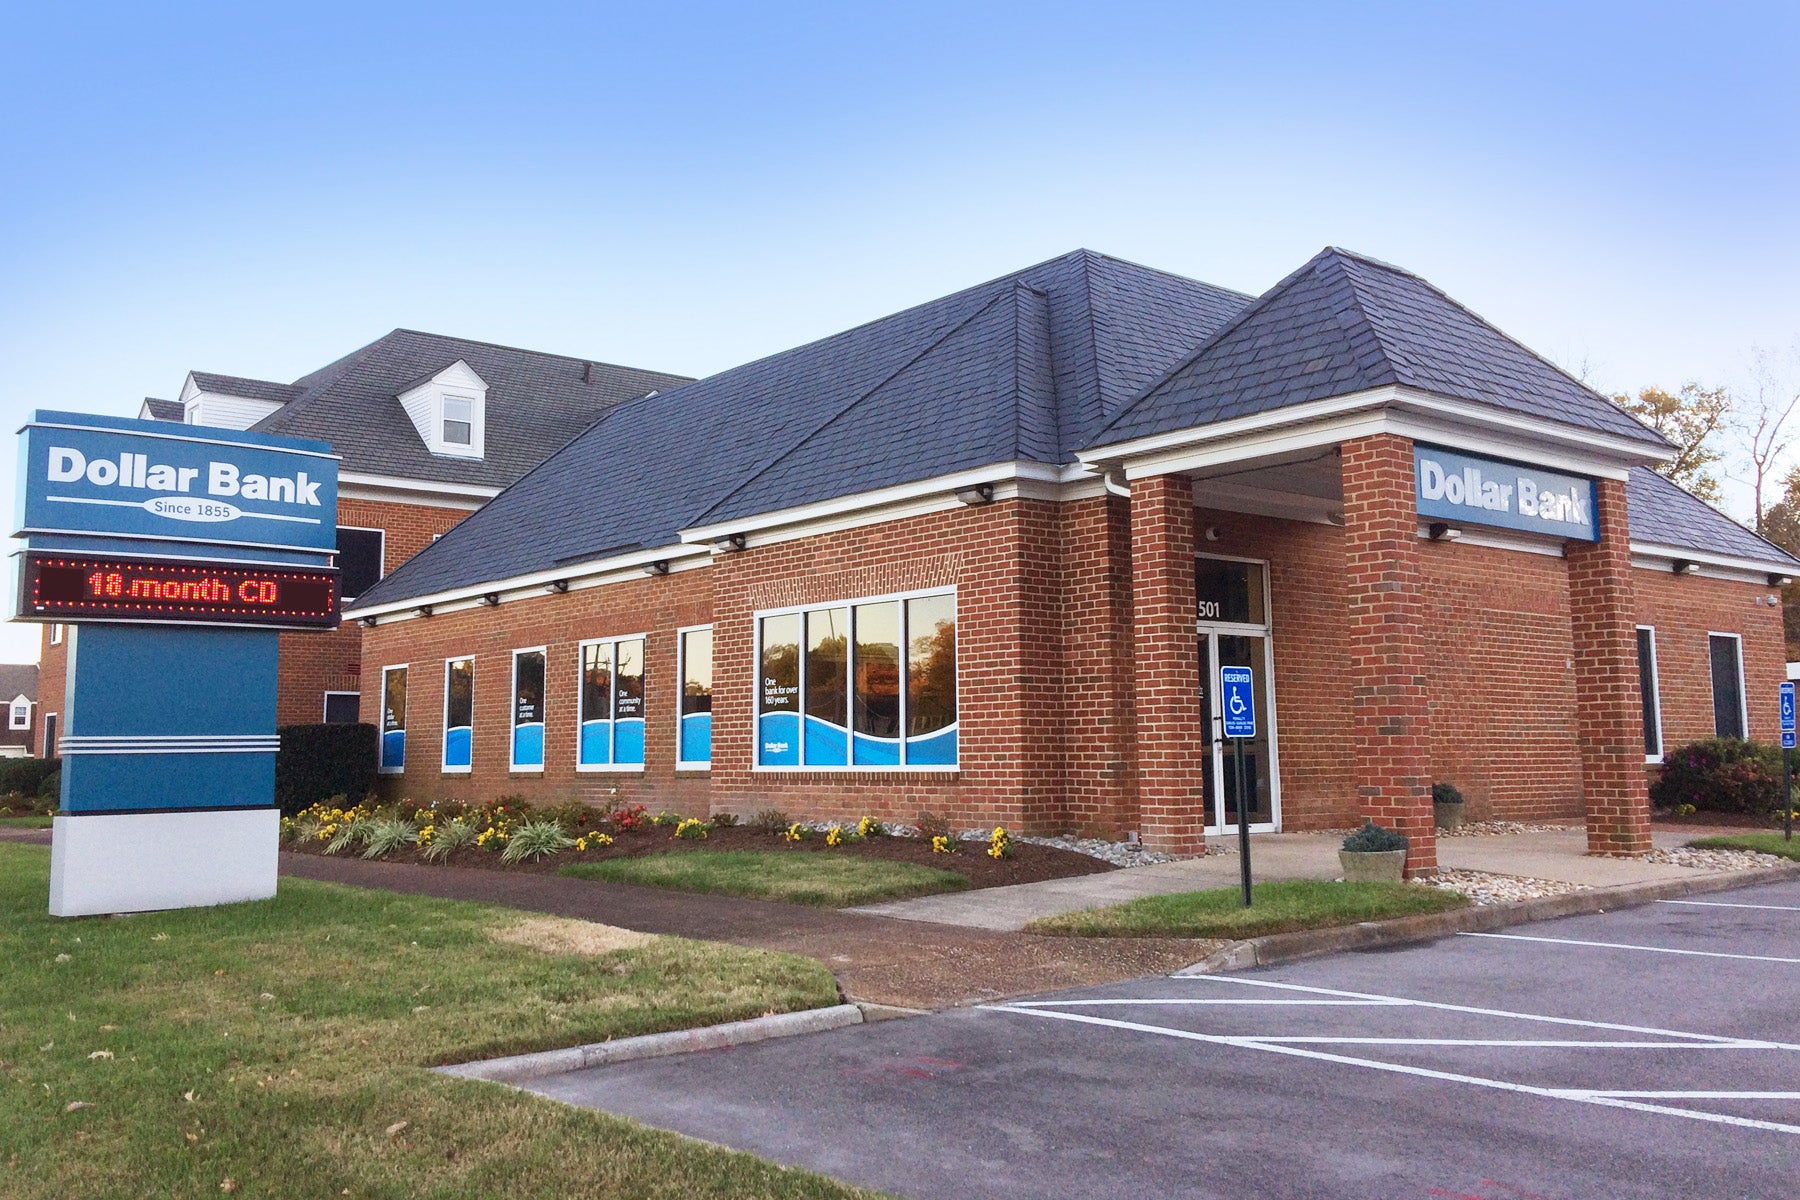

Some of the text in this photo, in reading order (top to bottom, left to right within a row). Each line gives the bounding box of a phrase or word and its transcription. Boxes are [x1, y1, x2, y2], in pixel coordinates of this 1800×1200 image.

[47, 446, 322, 506] Dollar Bank
[1420, 459, 1590, 526] Dollar Bank
[154, 501, 230, 518] Since 1855
[88, 572, 278, 604] 18 month CD
[1198, 600, 1220, 618] 501
[765, 677, 776, 686] One
[1224, 673, 1250, 684] RESERVED
[618, 689, 628, 697] One
[765, 686, 778, 696] bank
[786, 686, 798, 695] over
[765, 695, 774, 705] 160
